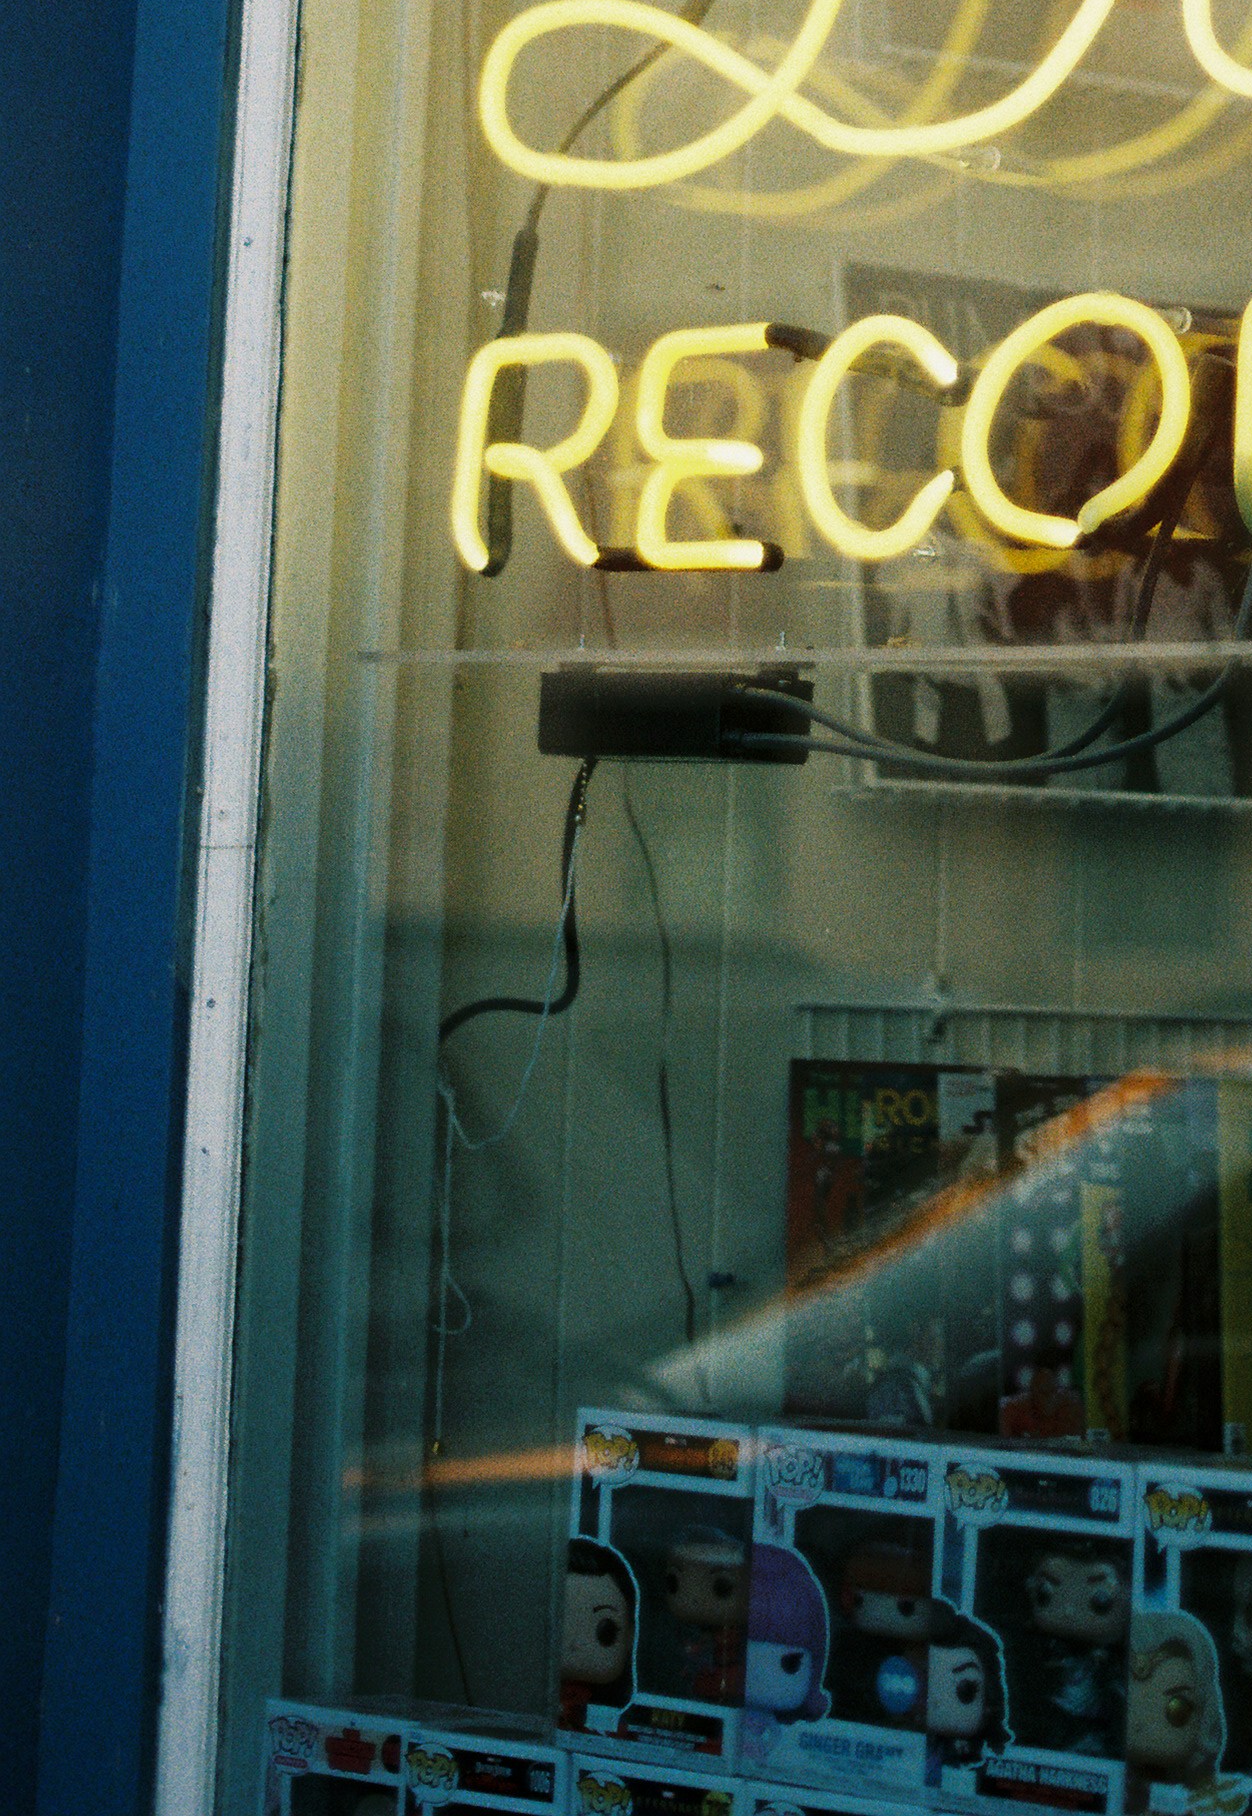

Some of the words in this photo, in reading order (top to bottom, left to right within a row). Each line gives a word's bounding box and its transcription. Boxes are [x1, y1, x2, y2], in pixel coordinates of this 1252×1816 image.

[764, 1444, 826, 1487] POP!
[946, 1469, 1006, 1512] POP!
[1144, 1488, 1210, 1531] POP!
[269, 1715, 320, 1759] POP!
[407, 1747, 459, 1790] POP!
